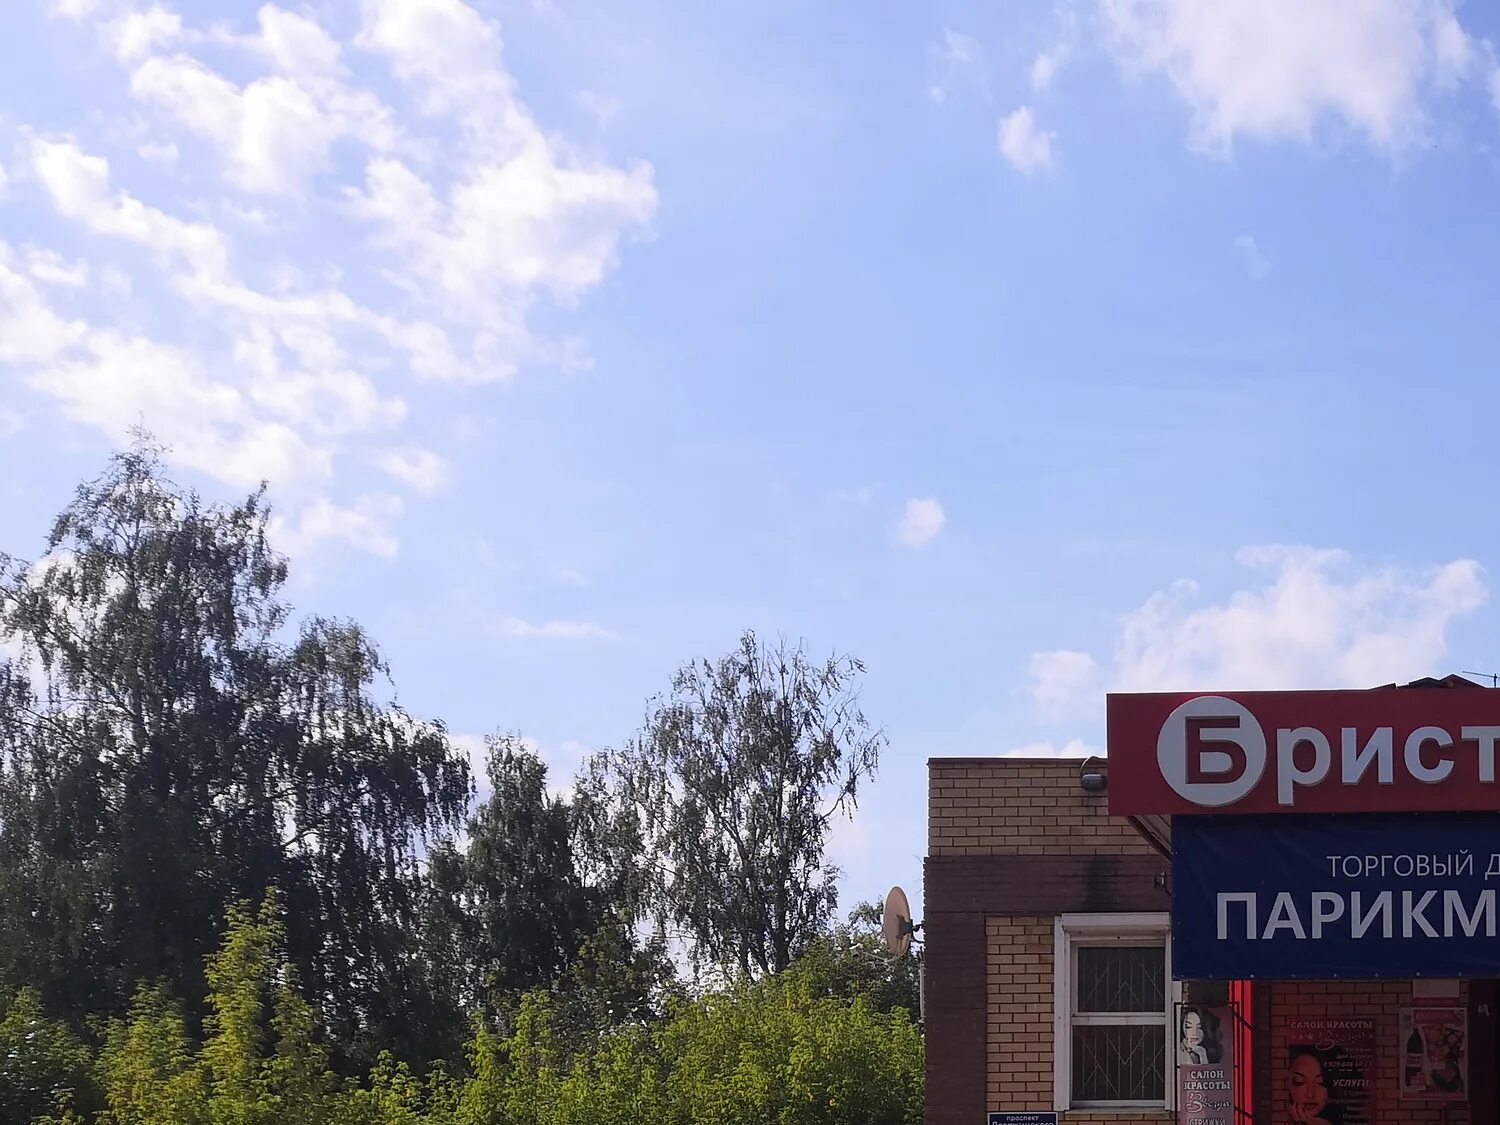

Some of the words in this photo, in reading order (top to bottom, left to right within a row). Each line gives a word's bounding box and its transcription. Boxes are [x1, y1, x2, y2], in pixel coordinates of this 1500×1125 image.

[1326, 849, 1475, 878] ТОРГОВЫЙ
[1190, 1070, 1224, 1078] САЛОН
[1184, 1081, 1231, 1090] КРАСОТЫ
